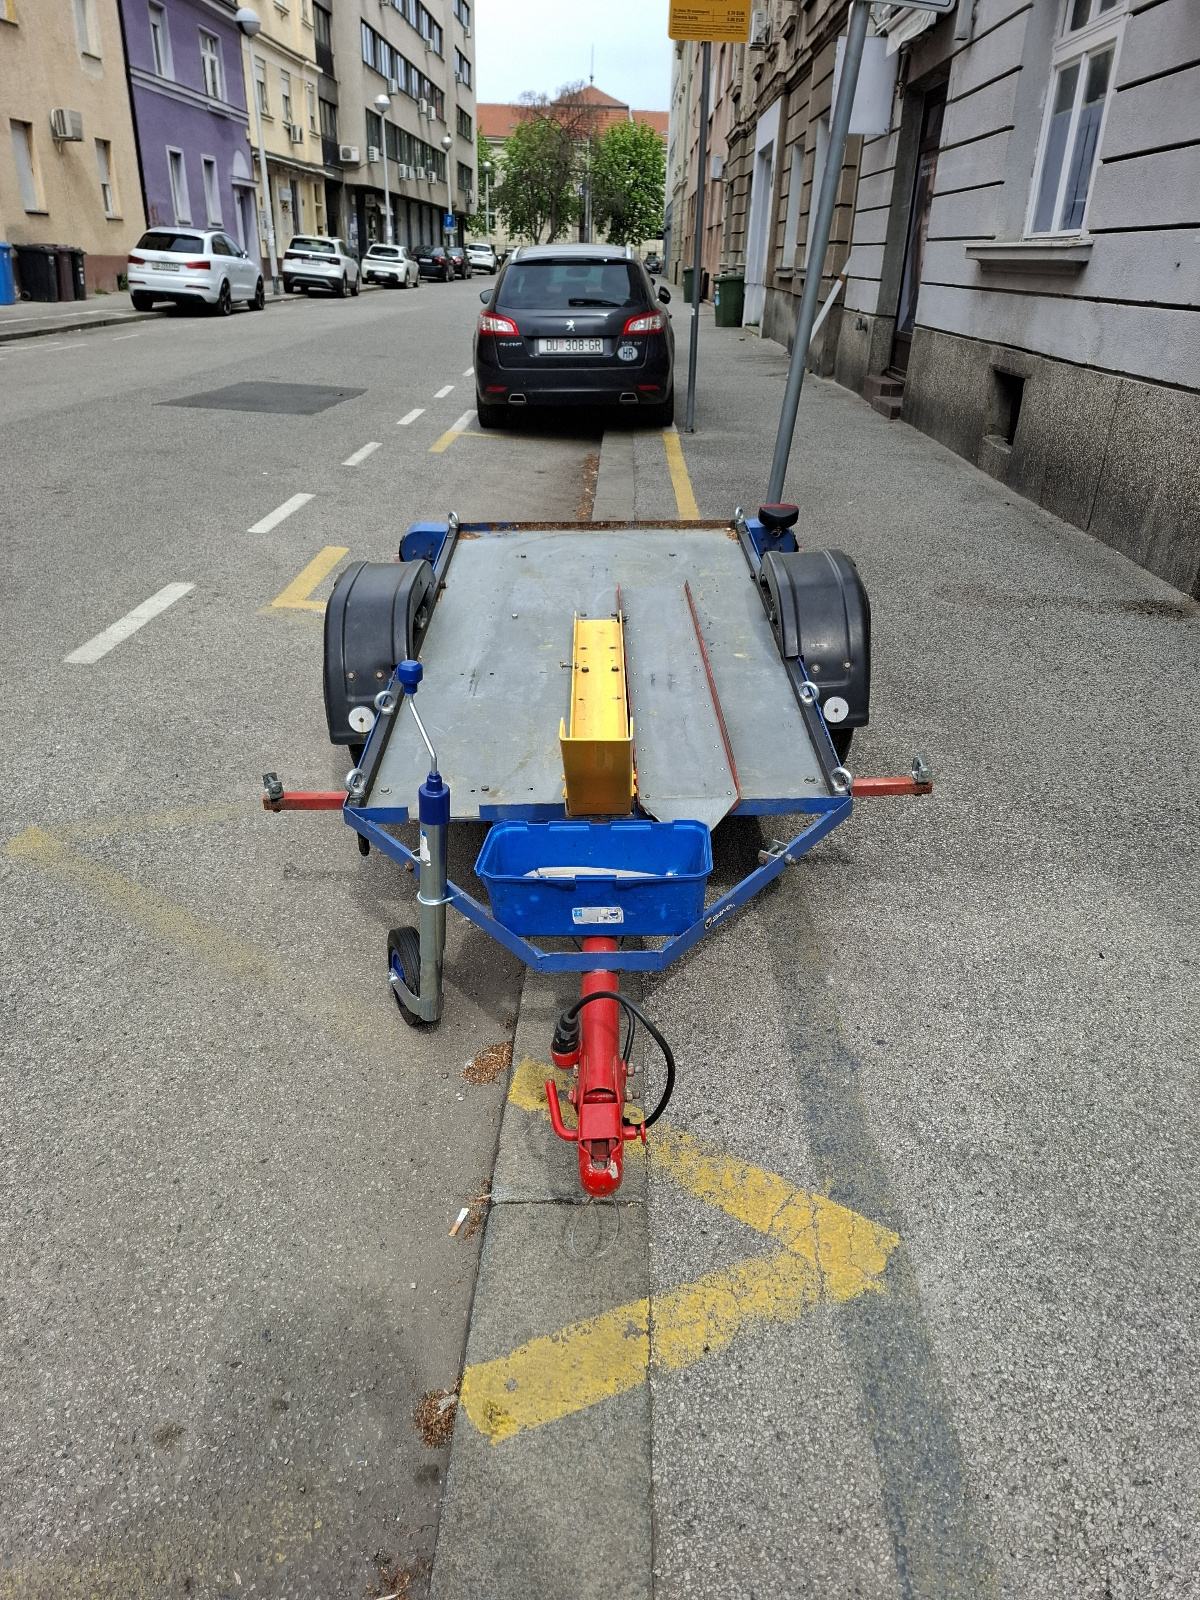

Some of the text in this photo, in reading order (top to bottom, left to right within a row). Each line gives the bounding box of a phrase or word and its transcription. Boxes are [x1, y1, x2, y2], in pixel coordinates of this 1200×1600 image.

[546, 339, 601, 351] DU 308-GR
[622, 347, 634, 359] HR
